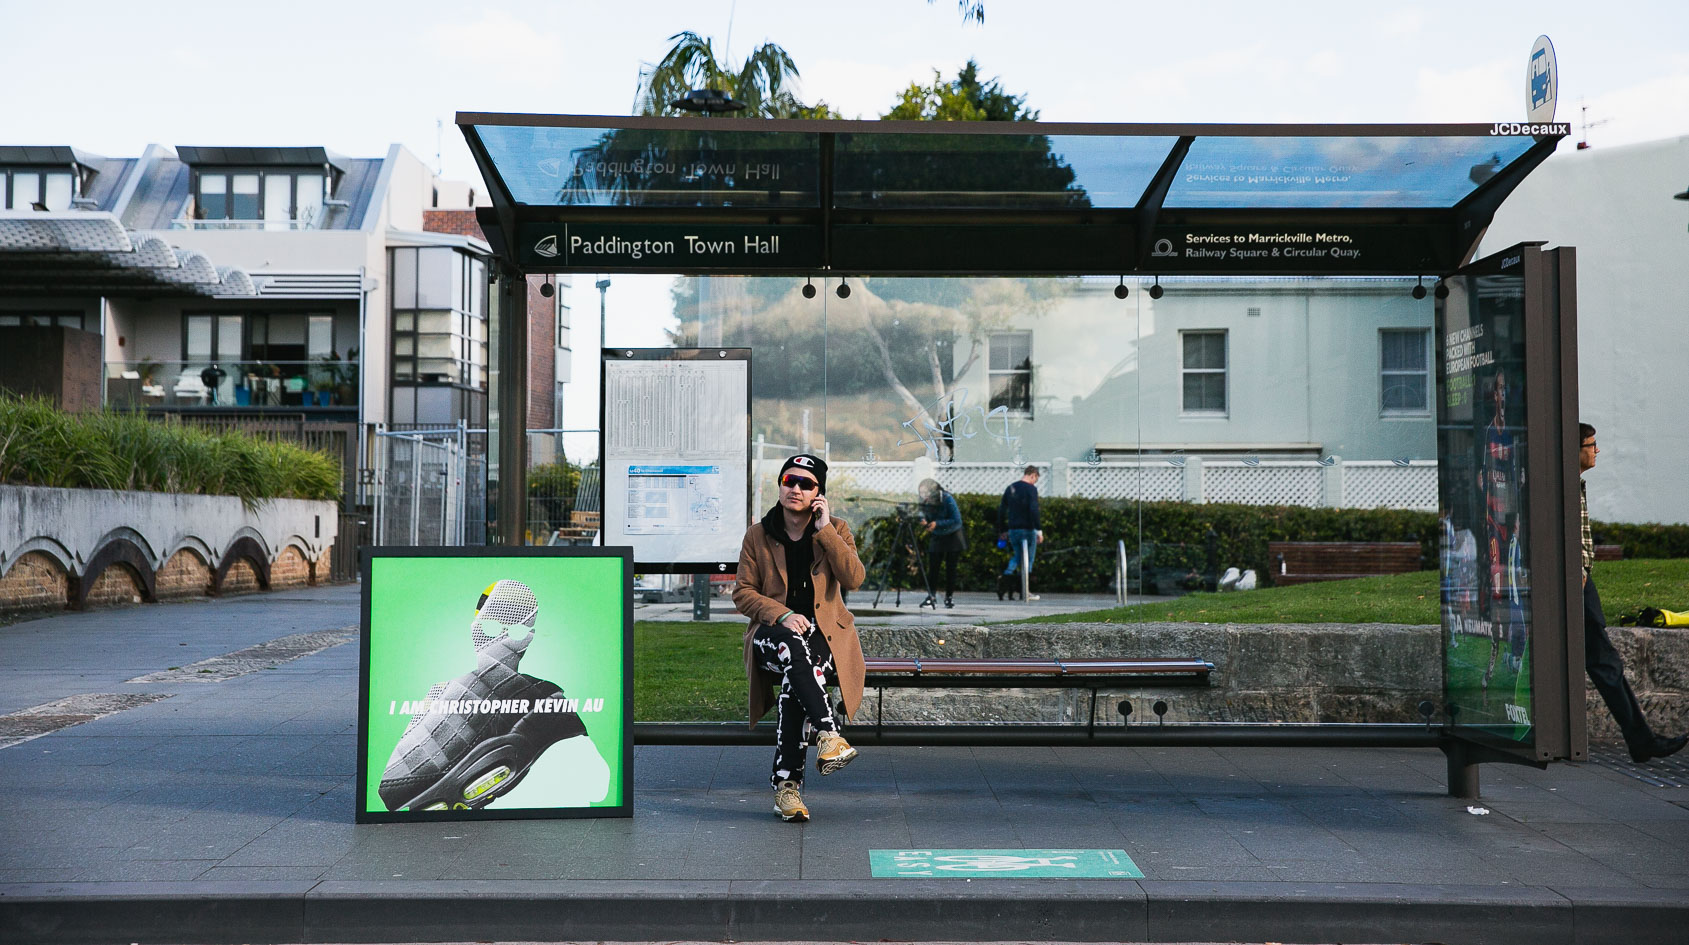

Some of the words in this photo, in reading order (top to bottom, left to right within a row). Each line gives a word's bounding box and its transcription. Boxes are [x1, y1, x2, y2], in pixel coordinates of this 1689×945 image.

[1490, 123, 1567, 135] JCDecaux
[1186, 233, 1231, 244] Services
[1233, 234, 1246, 244] to
[1248, 233, 1313, 243] Marrickville
[1315, 233, 1353, 244] Metro,
[571, 235, 675, 259] Paddington
[684, 235, 735, 254] Town
[744, 235, 780, 254] Hall
[1185, 248, 1227, 260] Railway
[1229, 247, 1269, 260] Square
[1271, 247, 1280, 257] &
[1283, 247, 1328, 257] Circular
[1330, 247, 1361, 259] Quay.
[389, 700, 396, 715] I
[399, 700, 425, 715] AM
[429, 698, 530, 715] CHRISTOPHER
[533, 698, 579, 714] KEVIN
[582, 698, 604, 713] AU
